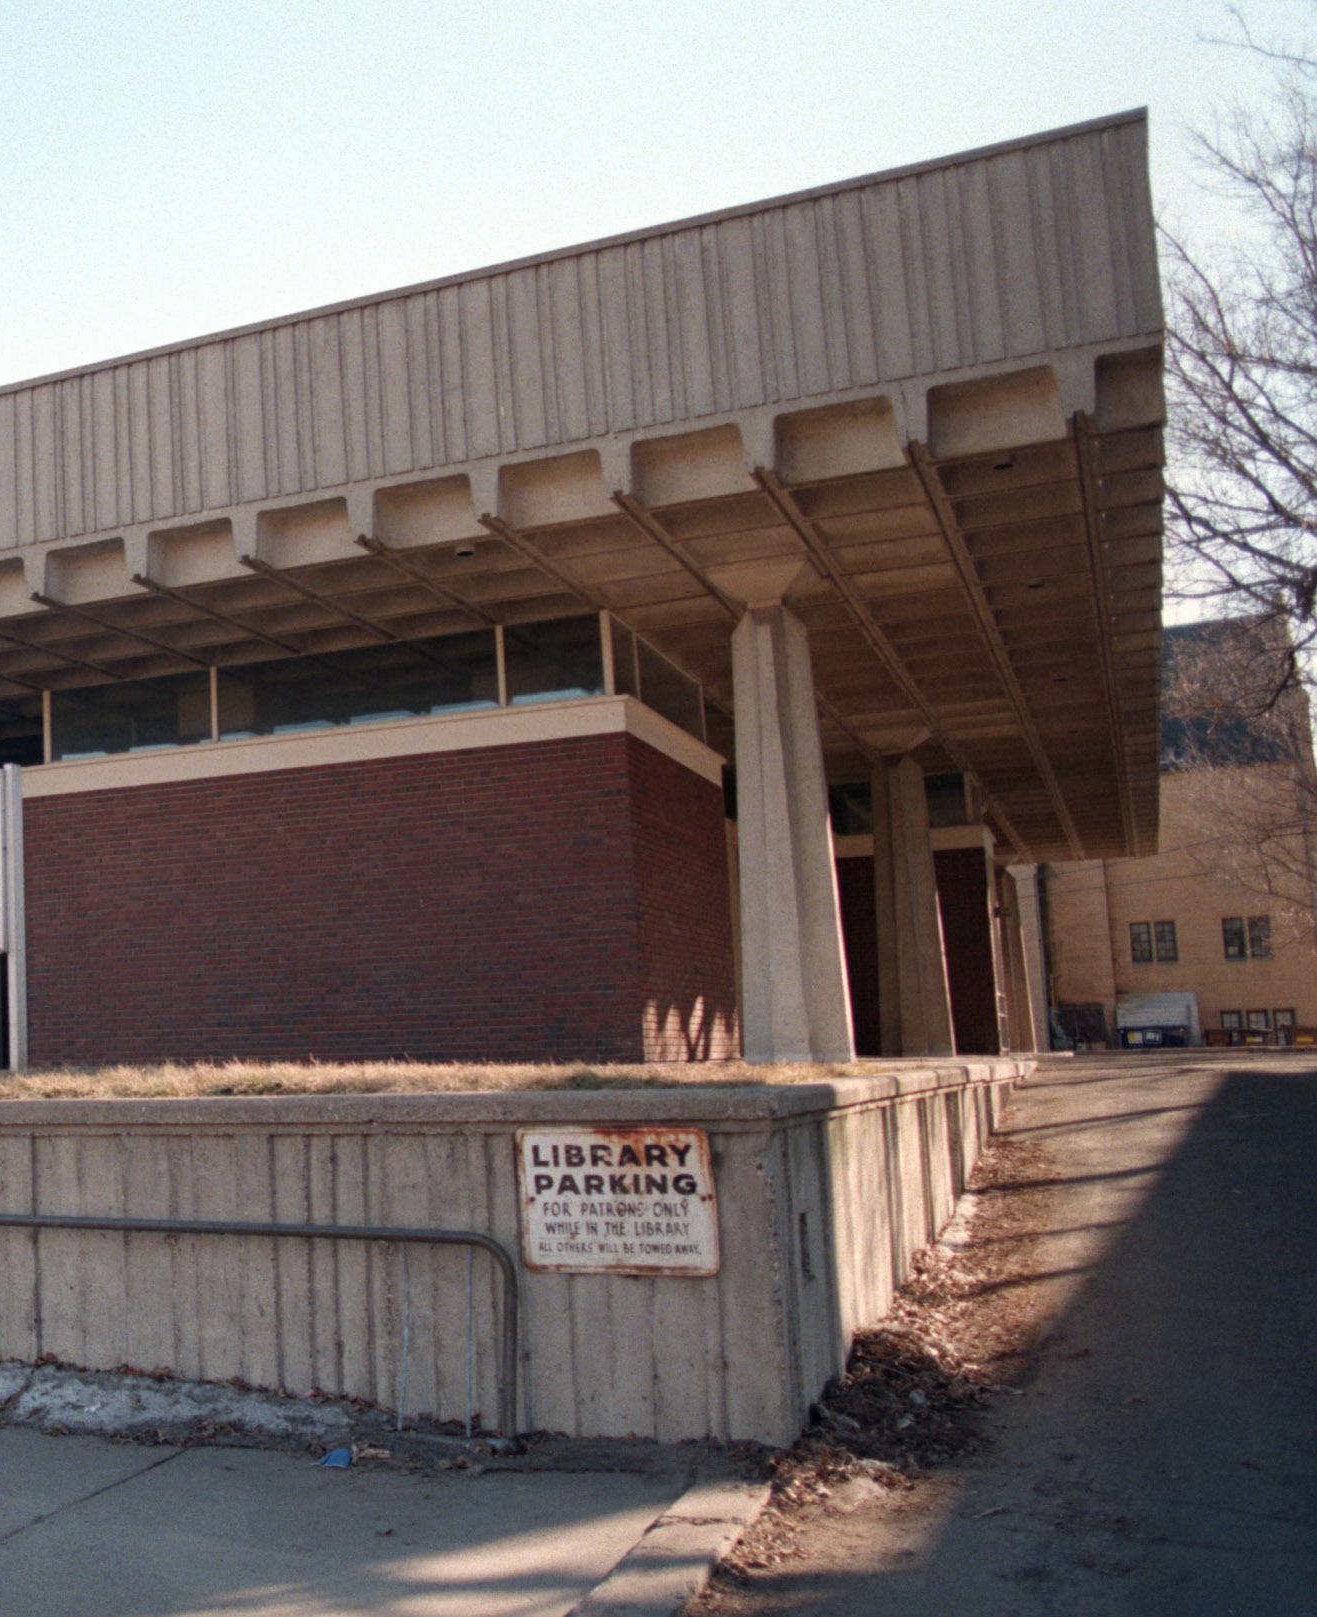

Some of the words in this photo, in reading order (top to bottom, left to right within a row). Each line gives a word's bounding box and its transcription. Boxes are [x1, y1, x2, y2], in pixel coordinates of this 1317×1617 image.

[532, 1144, 692, 1168] LIBRARY
[534, 1174, 697, 1196] PARKING
[543, 1201, 572, 1217] FOR
[580, 1201, 644, 1217] PATRONS
[653, 1201, 689, 1217] ONLY
[545, 1221, 580, 1235] WHILE
[586, 1221, 598, 1235] IN
[604, 1221, 625, 1236] THE
[634, 1221, 689, 1236] LIBRARY
[539, 1242, 553, 1252] ALL
[557, 1241, 593, 1253] OTHERS
[598, 1243, 619, 1253] WILL
[623, 1243, 634, 1254] BE
[639, 1243, 672, 1255] TOWED
